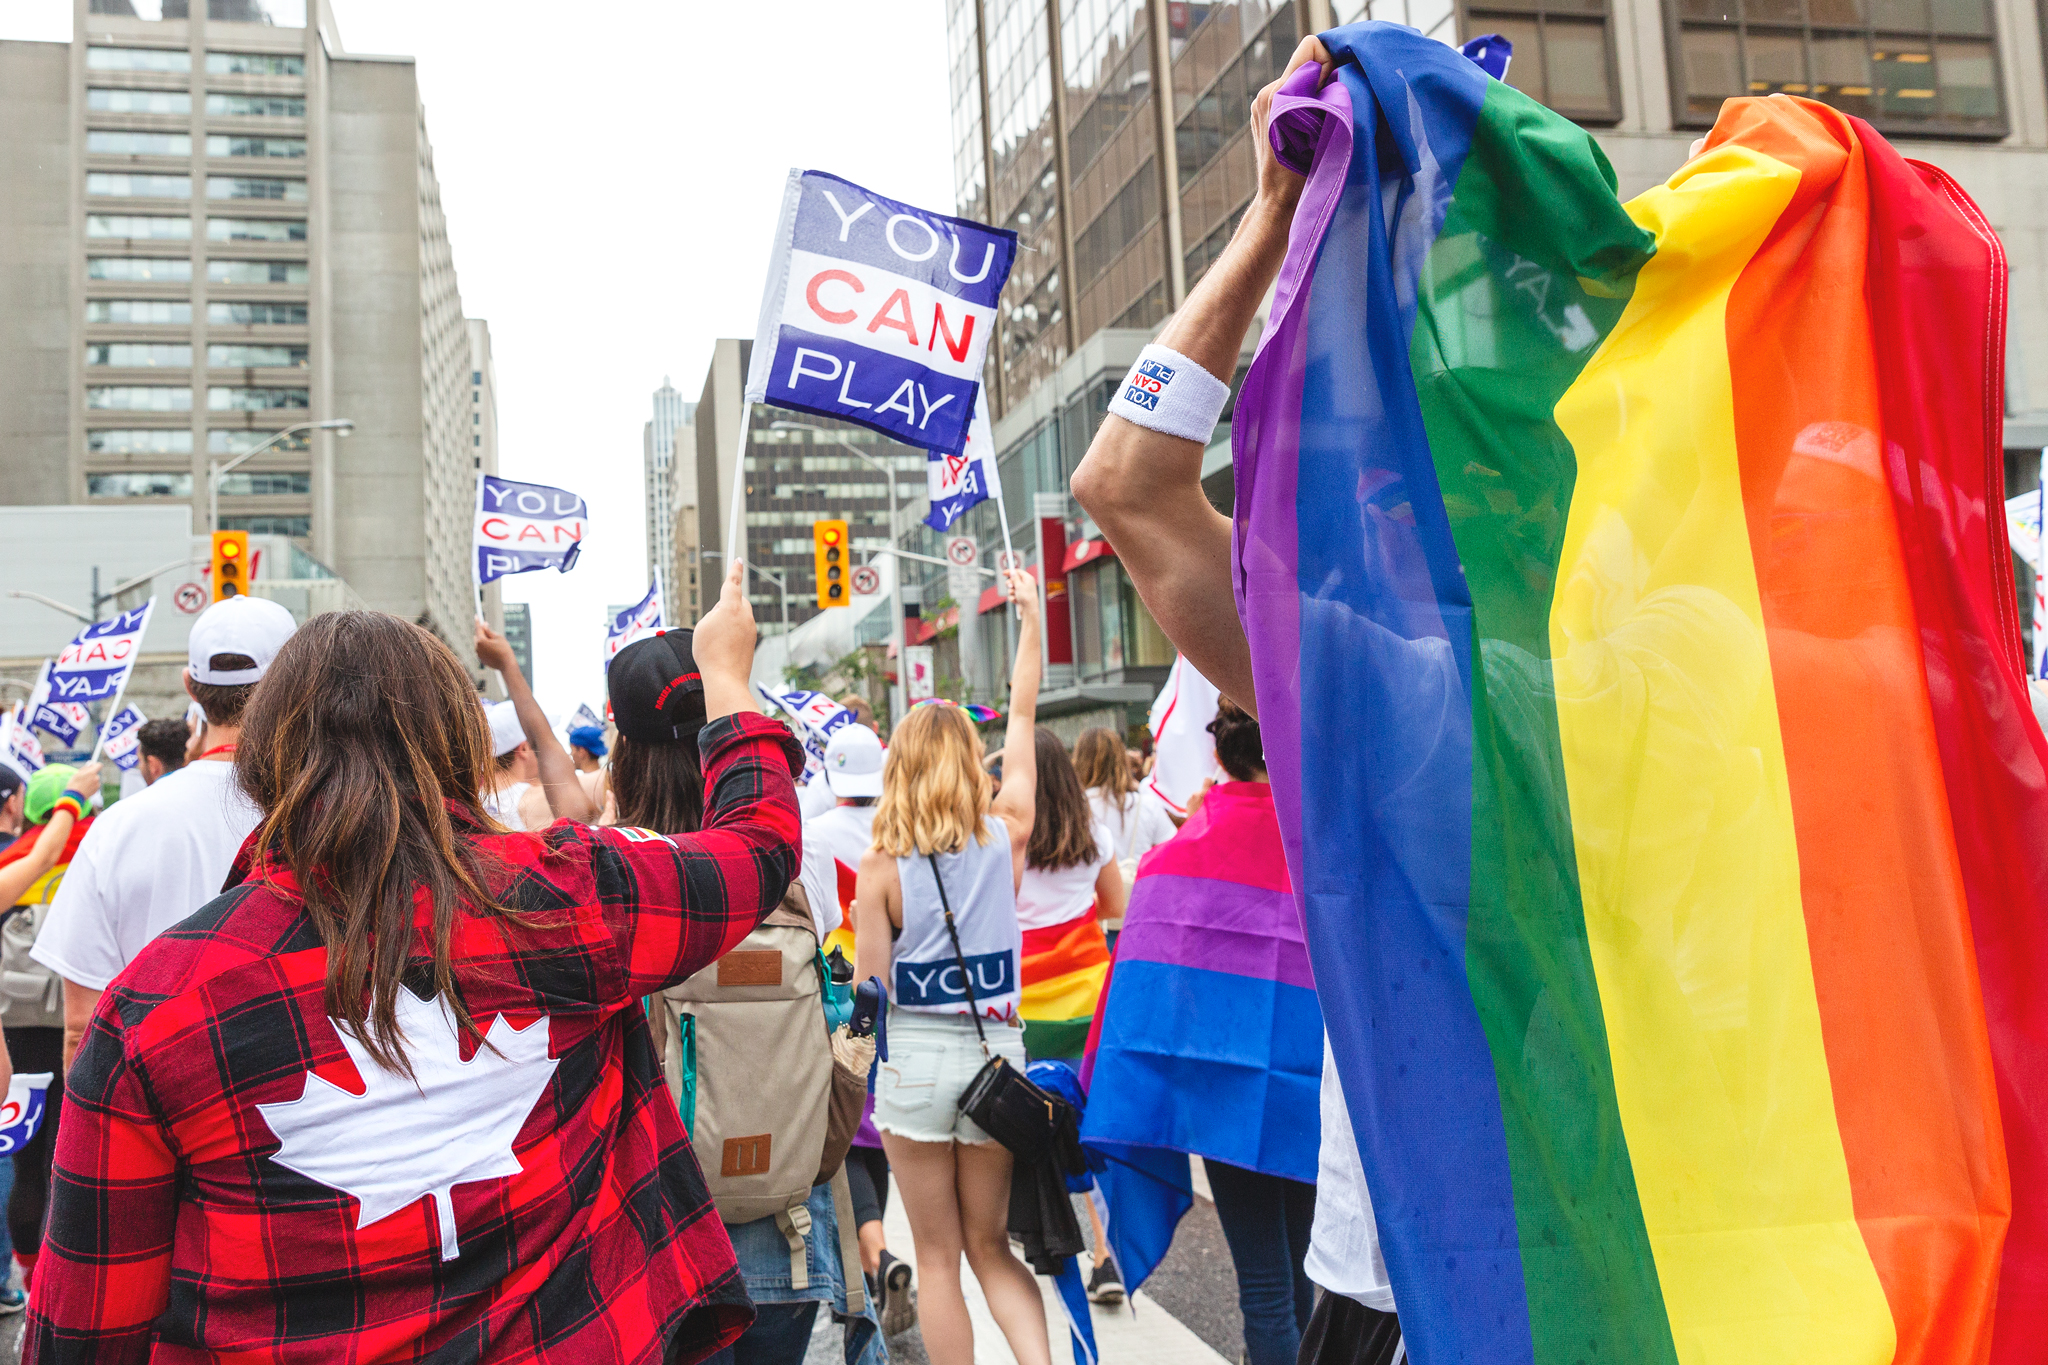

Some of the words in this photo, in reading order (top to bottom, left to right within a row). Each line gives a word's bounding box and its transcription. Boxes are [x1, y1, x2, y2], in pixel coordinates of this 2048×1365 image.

[822, 190, 996, 284] YOU
[806, 269, 976, 363] CAN
[1131, 373, 1162, 393] CAN
[1140, 360, 1175, 381] PLAY
[787, 347, 956, 430] PLAY
[1125, 387, 1155, 410] YOU
[486, 484, 583, 516] YOU
[481, 518, 582, 544] CAN
[670, 672, 701, 688] HOMETOW
[907, 960, 1005, 998] YOU
